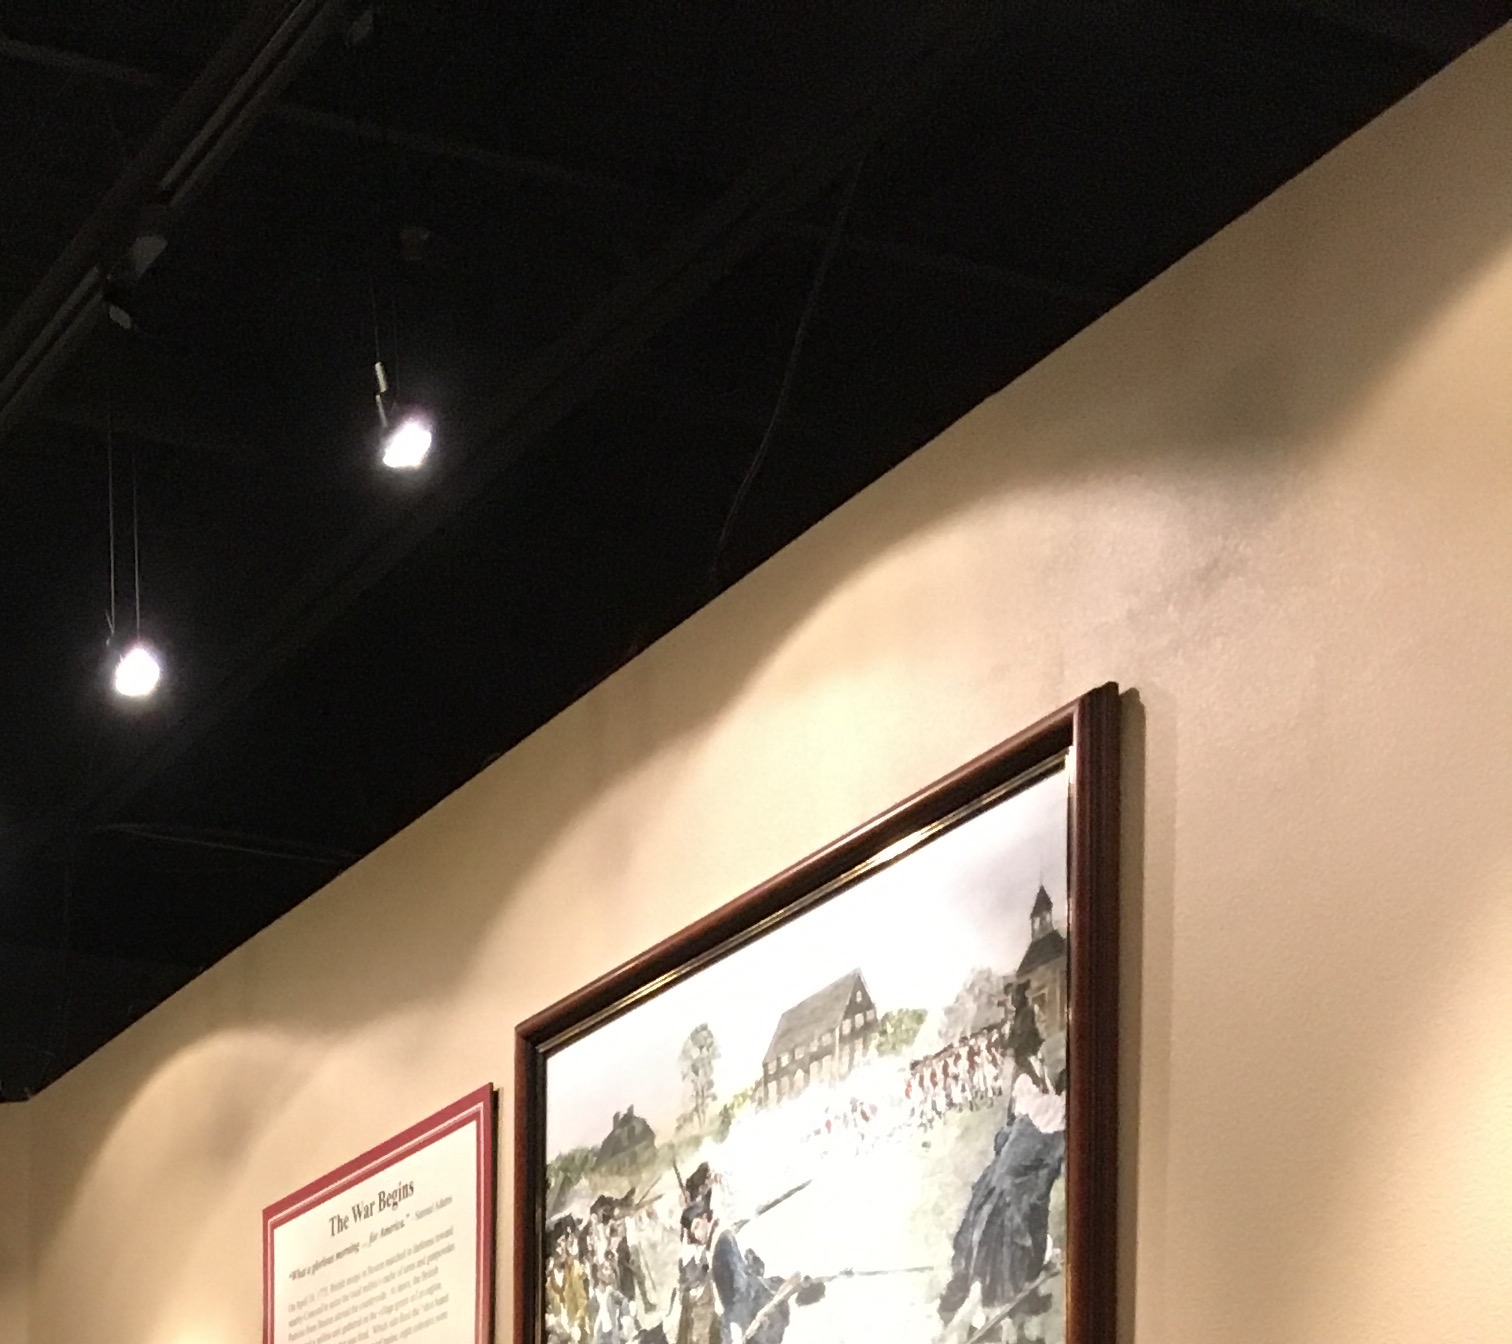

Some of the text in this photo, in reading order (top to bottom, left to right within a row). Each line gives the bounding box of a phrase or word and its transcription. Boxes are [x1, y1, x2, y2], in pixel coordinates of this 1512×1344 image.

[329, 1180, 414, 1237] The War Begins
